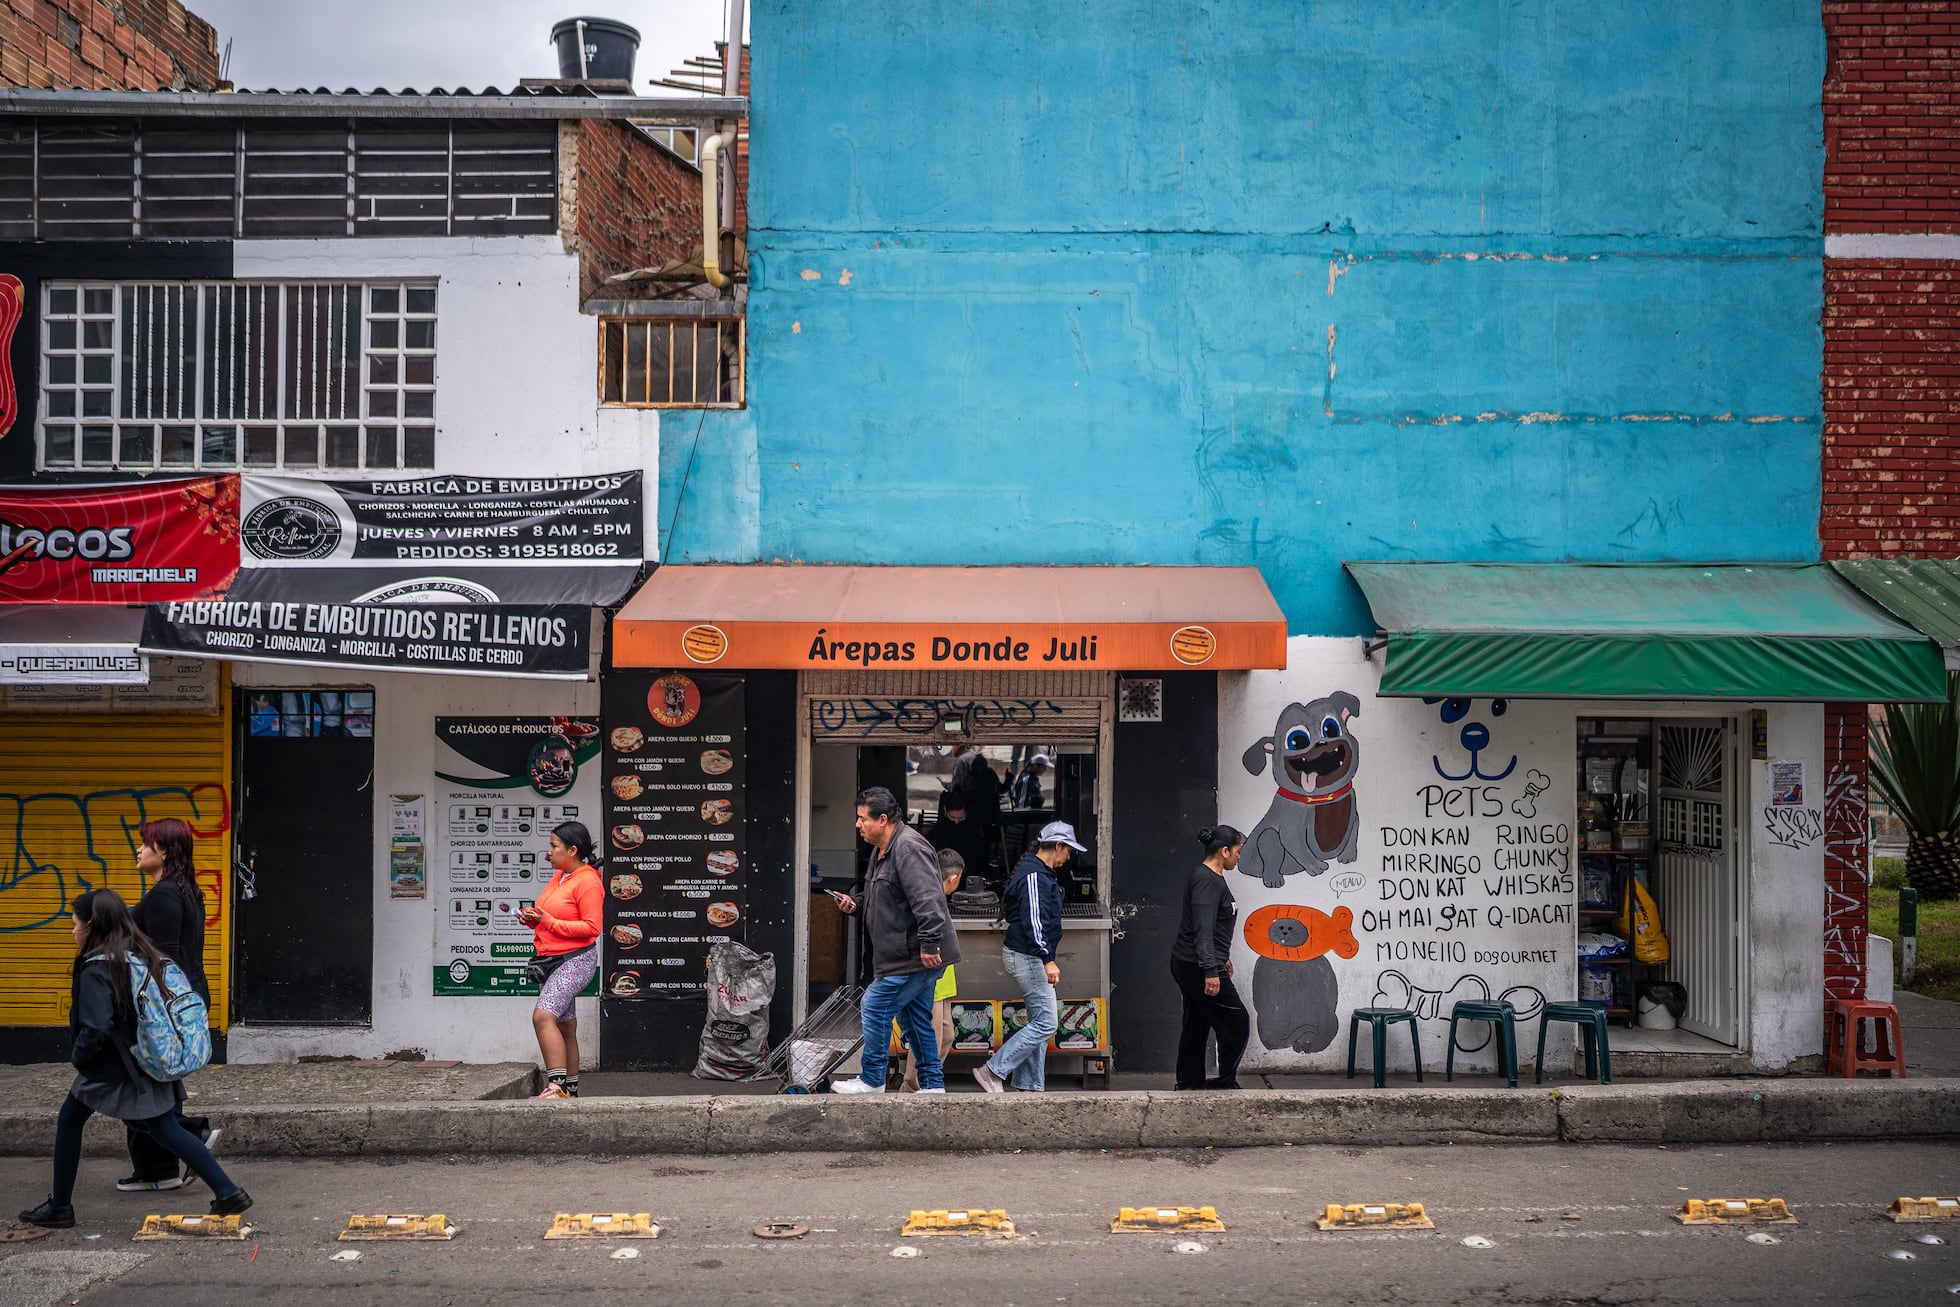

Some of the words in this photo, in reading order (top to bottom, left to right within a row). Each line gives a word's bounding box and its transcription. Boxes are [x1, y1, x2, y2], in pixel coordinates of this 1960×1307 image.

[372, 481, 460, 494] FABRICA
[466, 480, 493, 493] DE
[500, 477, 621, 492] EMBUTIDOS
[412, 502, 459, 510] MORCILLA
[468, 501, 522, 509] LONGANIZA
[576, 499, 629, 507] AHUMADAS
[386, 511, 437, 519] SALCHICHA
[473, 510, 489, 518] DE
[490, 509, 561, 517] HAMBURGUESA
[568, 508, 609, 516] CHULETA
[361, 528, 424, 541] JUEVES
[429, 528, 444, 539] Y
[446, 526, 519, 539] VIERNES
[533, 526, 545, 537] 8
[548, 525, 578, 537] AM
[593, 524, 631, 536] 5PM
[396, 546, 493, 559] PEDIDOS:
[498, 543, 618, 557] 3193518062
[92, 568, 197, 583] MARICHUELA
[269, 602, 298, 631] DE
[304, 604, 437, 640] EMBUTIDOS
[443, 612, 566, 647] RE'LLENOS
[206, 631, 254, 648] CHORIZO
[264, 635, 326, 653] LONGANIZA
[339, 640, 396, 657] MORCILLA
[407, 644, 466, 662] COSTILLAS
[469, 648, 484, 663] DE
[487, 649, 523, 665] CERDO
[808, 628, 915, 666] Árepas
[931, 637, 1029, 661] Donde
[1043, 636, 1098, 661] Juli
[17, 657, 141, 673] QUESADILLAS
[449, 723, 497, 734] CATÁLOGO
[500, 725, 511, 734] DE
[512, 725, 565, 734] PRODUCTOS
[1496, 824, 1569, 845] RINGO
[1383, 854, 1481, 875] MIRRINGO
[1494, 847, 1569, 874] CHUNKY
[1484, 874, 1574, 896] WHISKAS
[1362, 909, 1391, 932] OH
[1399, 907, 1431, 928] MAI
[450, 945, 485, 953] PEDIDOS
